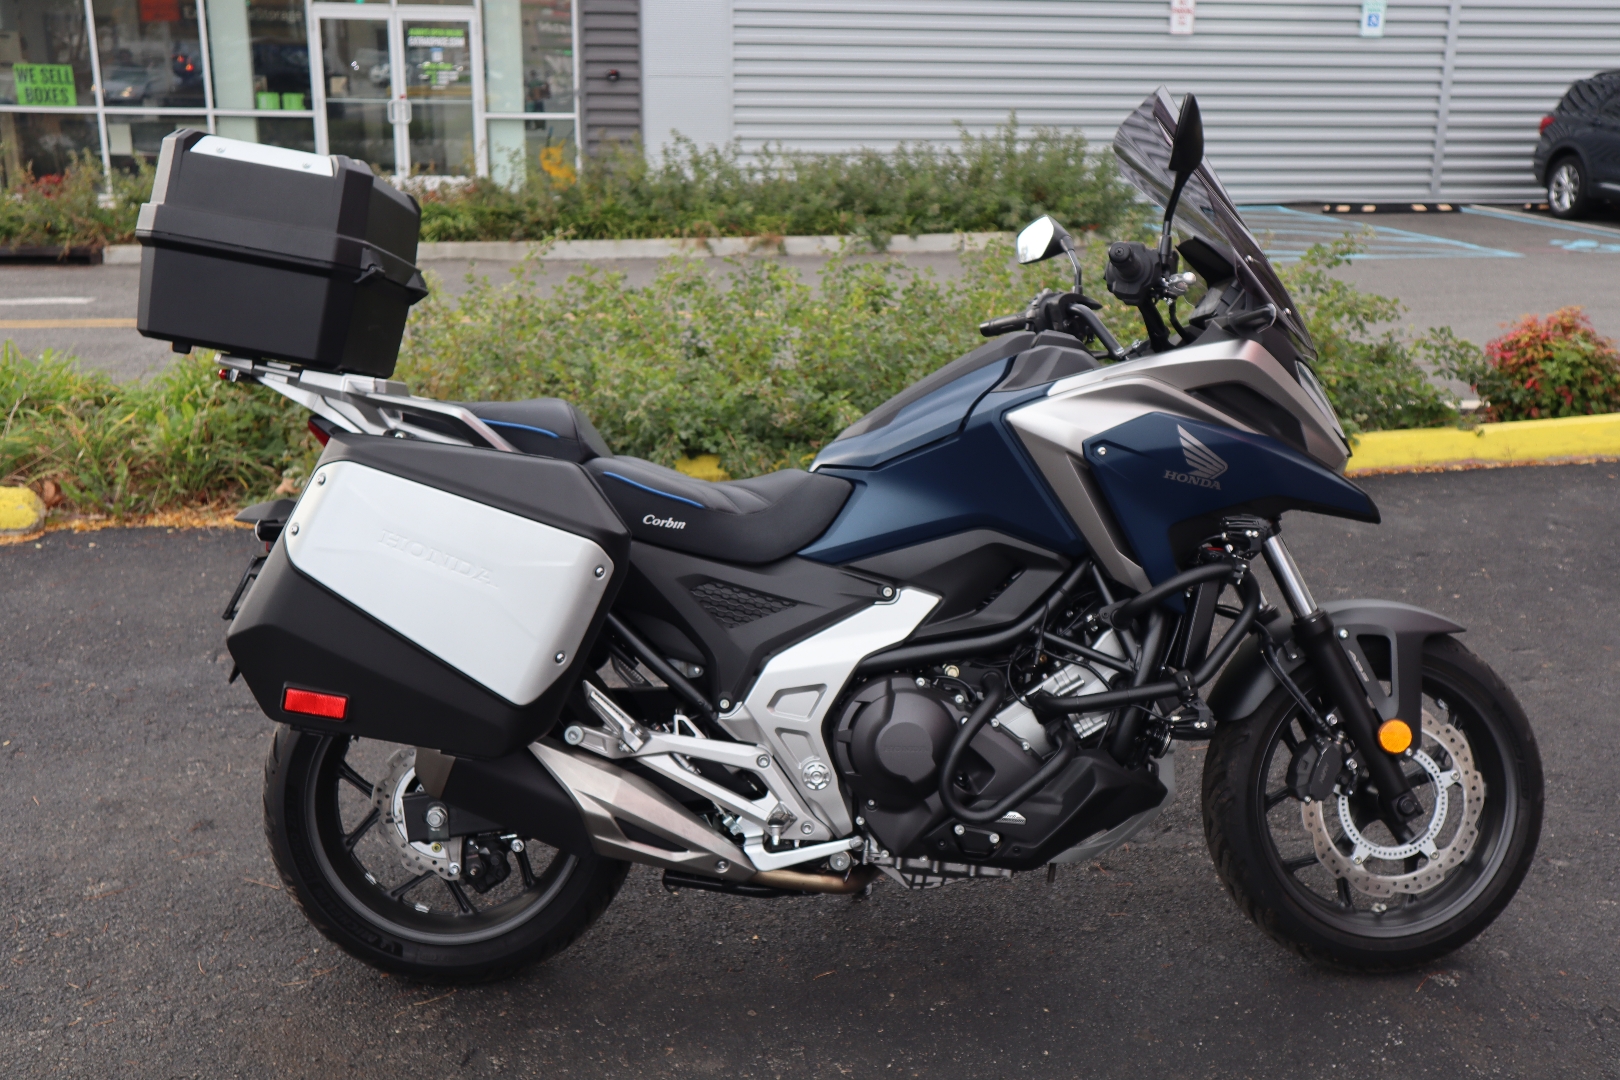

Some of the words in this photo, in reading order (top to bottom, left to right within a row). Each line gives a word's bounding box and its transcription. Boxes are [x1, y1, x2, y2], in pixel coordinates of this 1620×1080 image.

[15, 66, 37, 84] WE
[40, 67, 73, 86] SELL
[25, 86, 69, 104] BOXES
[1163, 469, 1221, 491] HONDA
[642, 513, 686, 530] Corbin
[378, 528, 499, 590] HONDA
